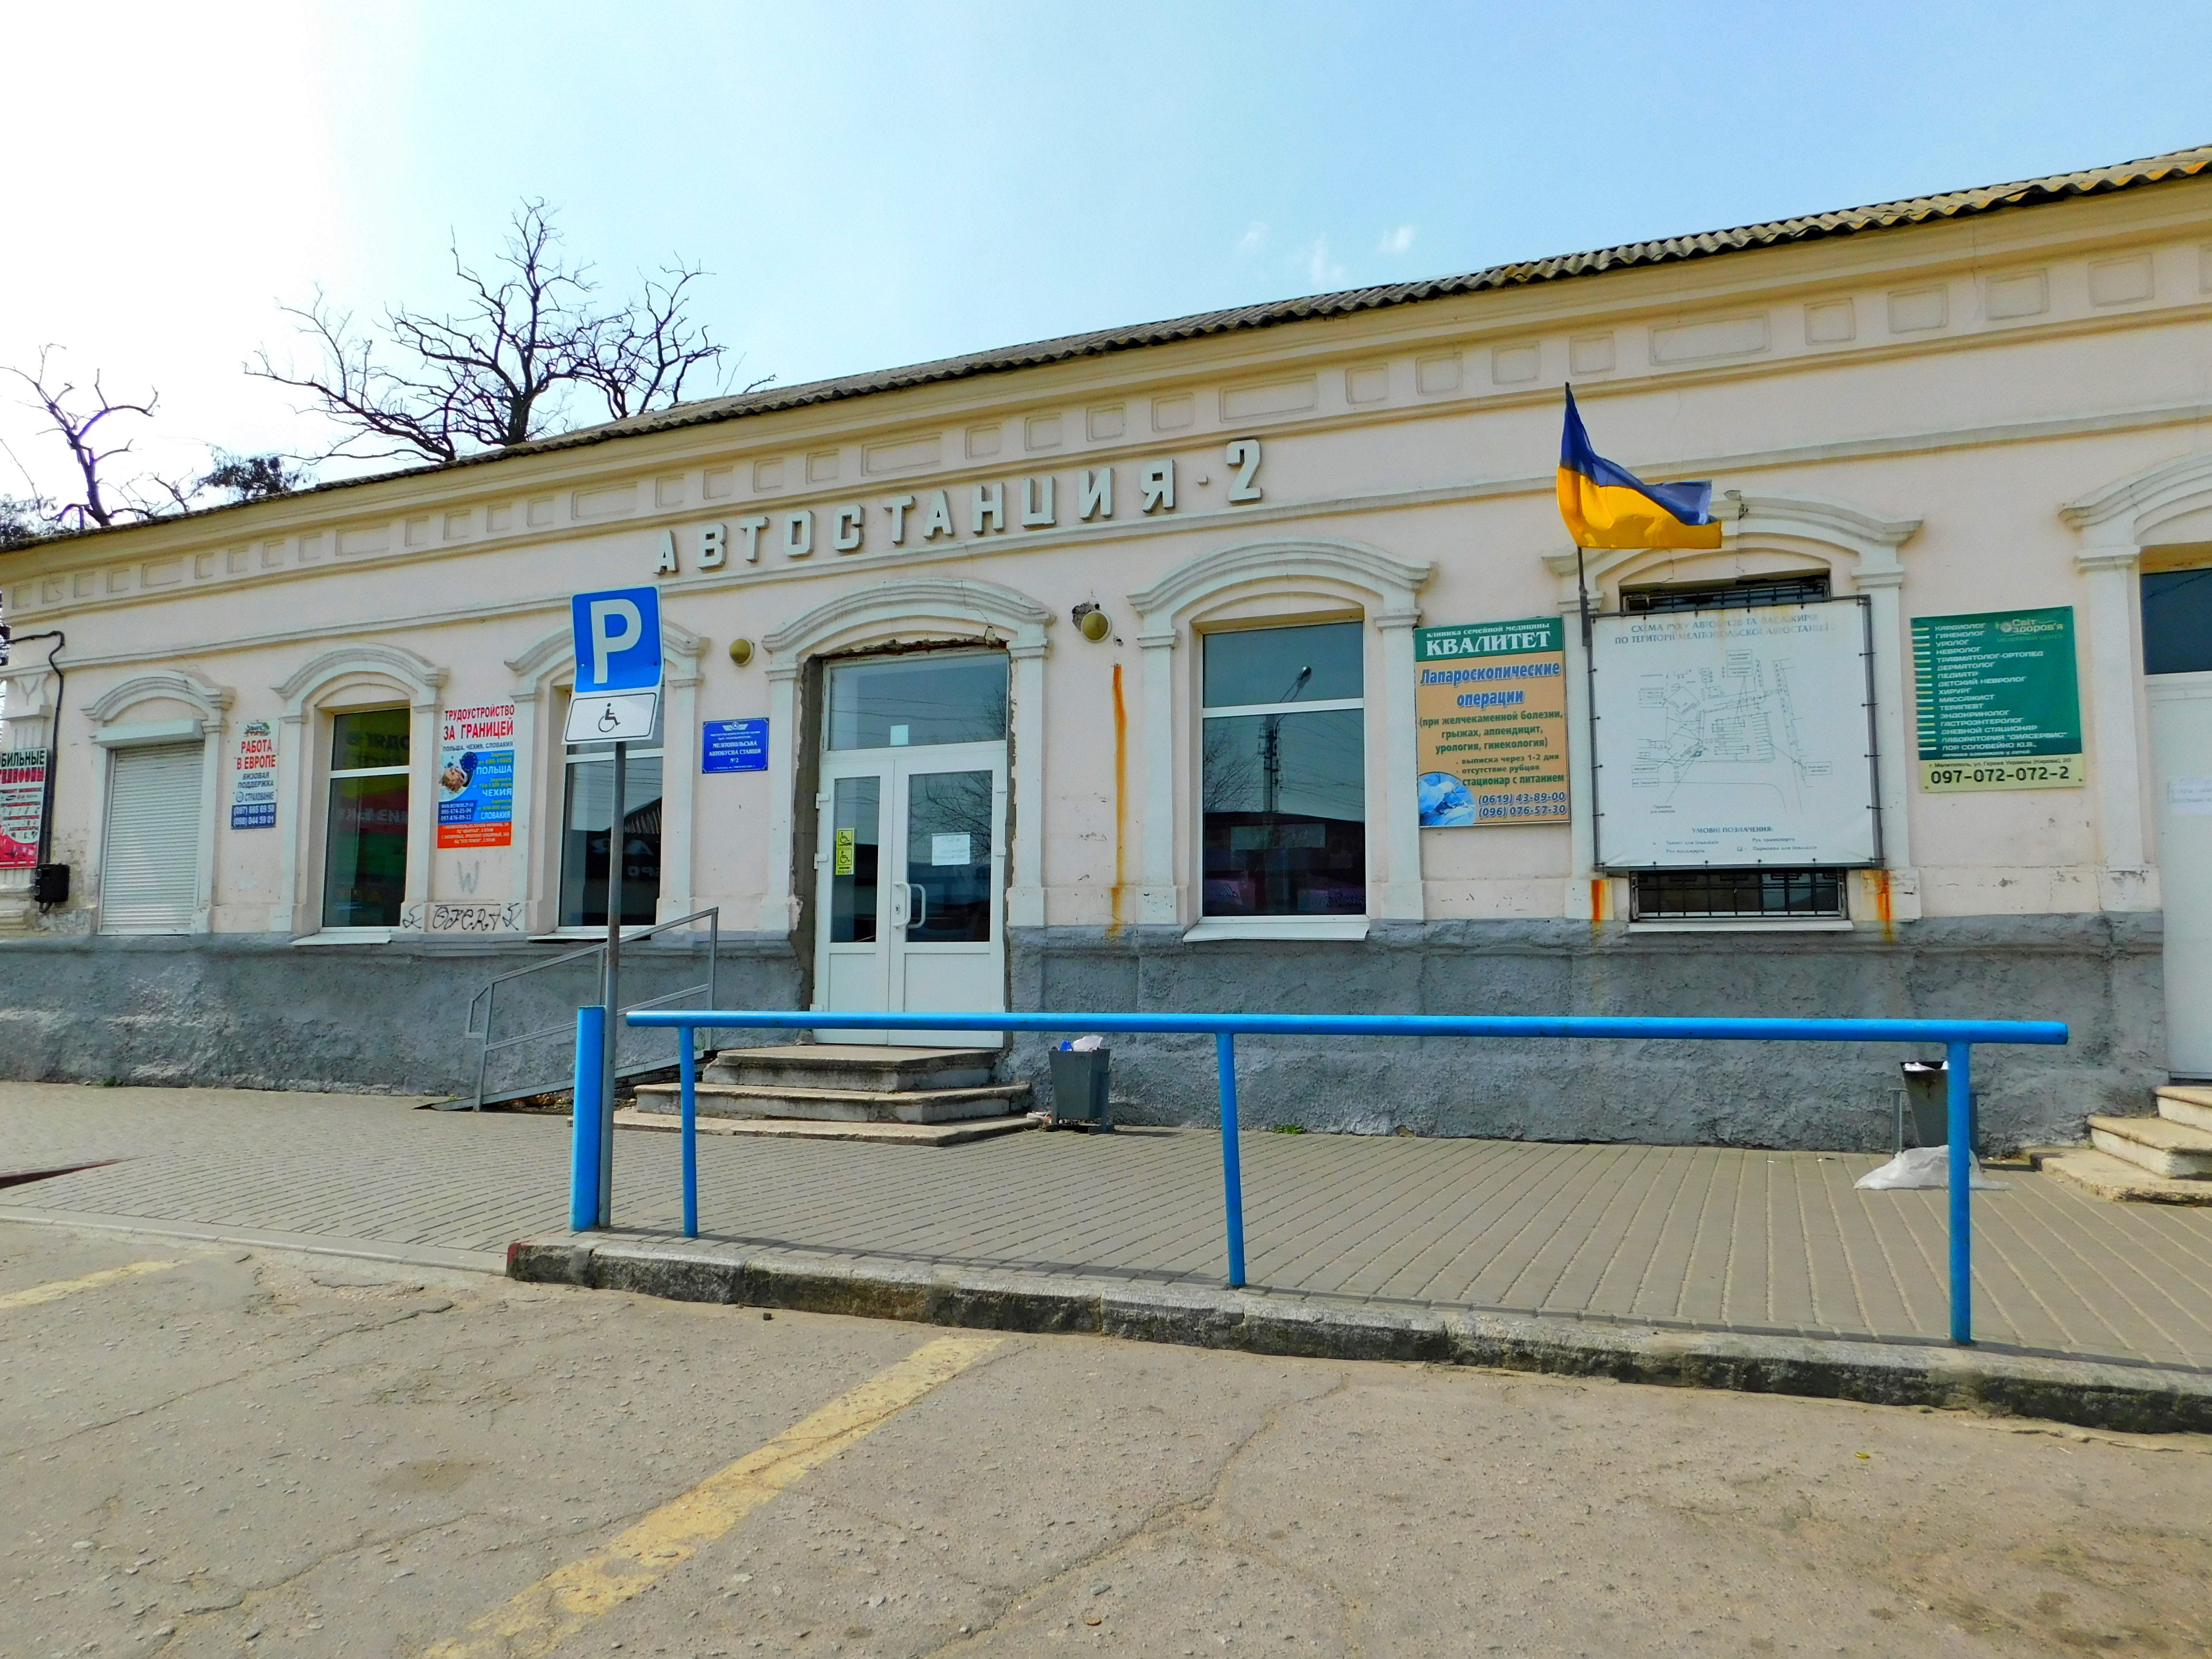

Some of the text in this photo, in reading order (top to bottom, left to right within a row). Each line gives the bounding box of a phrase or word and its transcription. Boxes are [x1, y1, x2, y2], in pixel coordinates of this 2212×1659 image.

[1463, 626, 1503, 635] семейной
[1505, 623, 1550, 632] медицины
[1631, 624, 1663, 633] СХЕМА
[1935, 623, 1985, 631] КАРДИОЛОГ
[1935, 630, 1985, 639] ГИНЕКОЛОГ
[590, 599, 642, 684] P
[1426, 631, 1551, 656] КВАЛИТЕТ
[1936, 647, 1982, 655] НЕВРОЛОГ
[1936, 651, 2044, 662] ТРАВМАТОЛОГ-ОРТОПЕД
[1937, 661, 1996, 671] ДЕРМАТОЛОГ
[1420, 661, 1561, 687] Лапароскопические
[1937, 671, 1978, 679] ПЕДИАТР
[1938, 676, 2026, 687] ДЕТСКИЙ НЕВРОЛОГ
[1456, 690, 1525, 709] операции
[1939, 694, 1996, 703] МАССАЖИСТ
[445, 703, 515, 722] ТРУДОУСТРОЙСТВО
[1939, 703, 1984, 711] ТЕРАПЕВТ
[1419, 710, 1563, 728] (при желчекаменной болезни,
[1939, 710, 2010, 719] ЭНДОКРИНОЛОГ
[1940, 717, 2024, 727] ГАСТРОЭНТЕРОЛОГ
[444, 717, 513, 741] ЗА ГРАНИЦЕЙ
[1442, 725, 1543, 740] грыжах, аппендицит,
[1941, 725, 2038, 735] ДНЕВНОЙ СТАЦИОНАР
[1941, 734, 2005, 743] ЛАБОРАТОРИЯ
[241, 739, 272, 754] РАБОТА
[1435, 737, 1548, 755] урология, гинекология)
[1961, 742, 2014, 750] СОЛОВЕЙКО
[0, 750, 45, 767] БИЛЬНЫЕ
[237, 755, 276, 769] В ЕВРОПЕ
[1461, 757, 1498, 765] выписка
[1501, 755, 1525, 764] через
[1543, 753, 1560, 761] дня
[476, 765, 512, 775] ПОЛЬША
[1462, 764, 1540, 775] отсутствие рубцов
[1930, 766, 2069, 784] 097-072-072-2
[238, 780, 274, 789] ПОДДЕРЖКА
[1462, 773, 1564, 787] стационар с питанием
[482, 788, 512, 796] ЧЕХИЯ
[1479, 791, 1566, 805] (0619) 43-89-00
[481, 811, 510, 819] СЛОВАКИЯ
[1479, 805, 1566, 819] (096) 076-57-30
